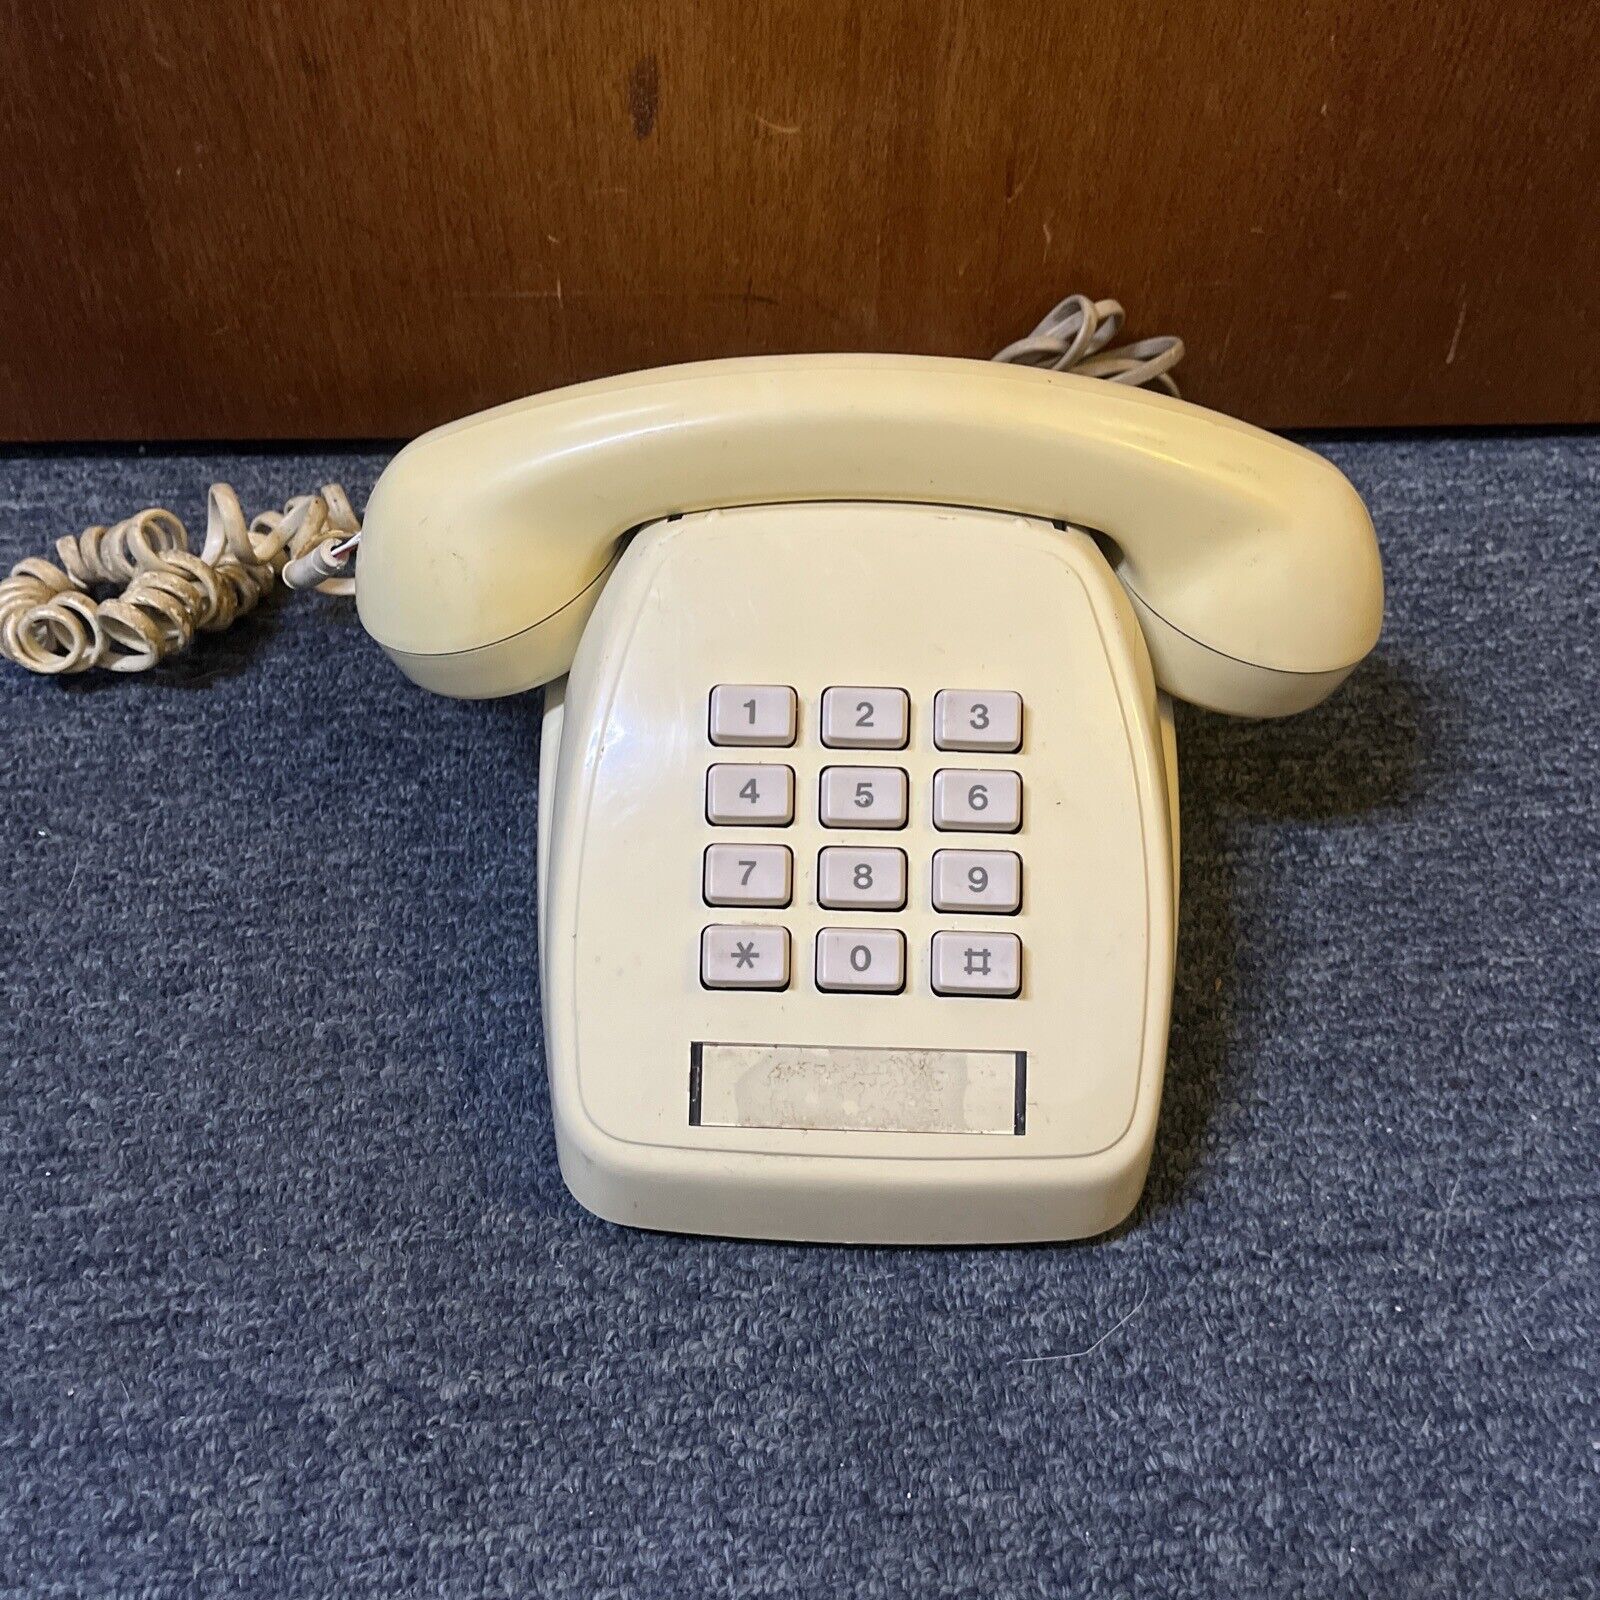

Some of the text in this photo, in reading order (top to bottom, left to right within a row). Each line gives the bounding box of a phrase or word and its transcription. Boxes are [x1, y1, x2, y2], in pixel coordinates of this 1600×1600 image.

[742, 698, 757, 726] 1
[854, 701, 875, 728] 2
[968, 703, 990, 730] 3
[738, 778, 760, 804] 4
[853, 781, 874, 808] 5
[967, 784, 990, 811] 6
[737, 859, 758, 886] 7
[852, 863, 874, 890] 8
[967, 866, 989, 893] 9
[849, 944, 872, 972] 0
[963, 947, 992, 976] #
